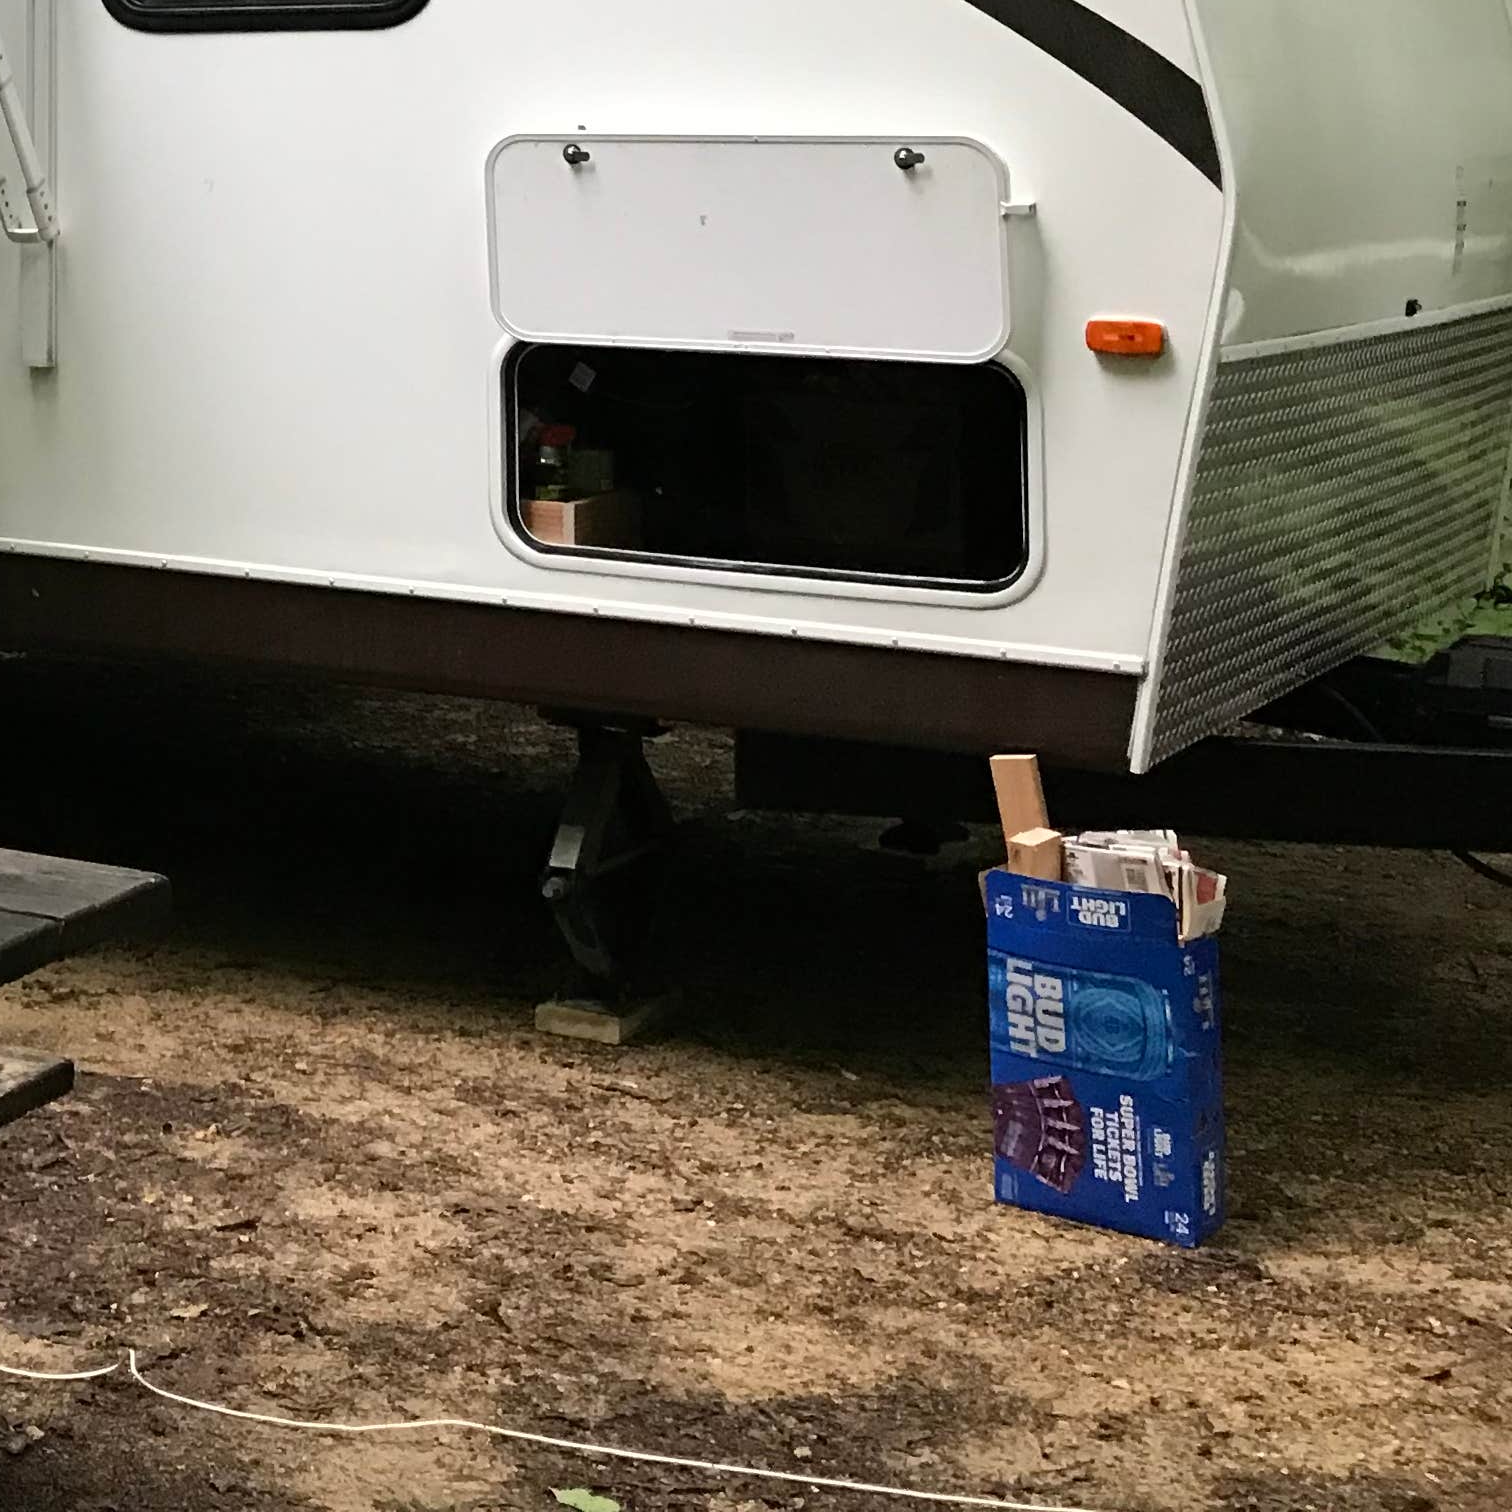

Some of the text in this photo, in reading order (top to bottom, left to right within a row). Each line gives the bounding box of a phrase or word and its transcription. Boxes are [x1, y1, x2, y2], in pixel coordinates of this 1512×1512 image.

[1070, 896, 1126, 916] LIGHT
[1078, 910, 1120, 928] BUD
[1006, 956, 1038, 1058] LIGHT
[1033, 973, 1067, 1053] BUD
[1090, 1106, 1109, 1181] FOR LIFE
[1105, 1111, 1123, 1183] TICKETS
[1119, 1094, 1139, 1203] SUPER BOWL
[1175, 1212, 1190, 1235] 24
